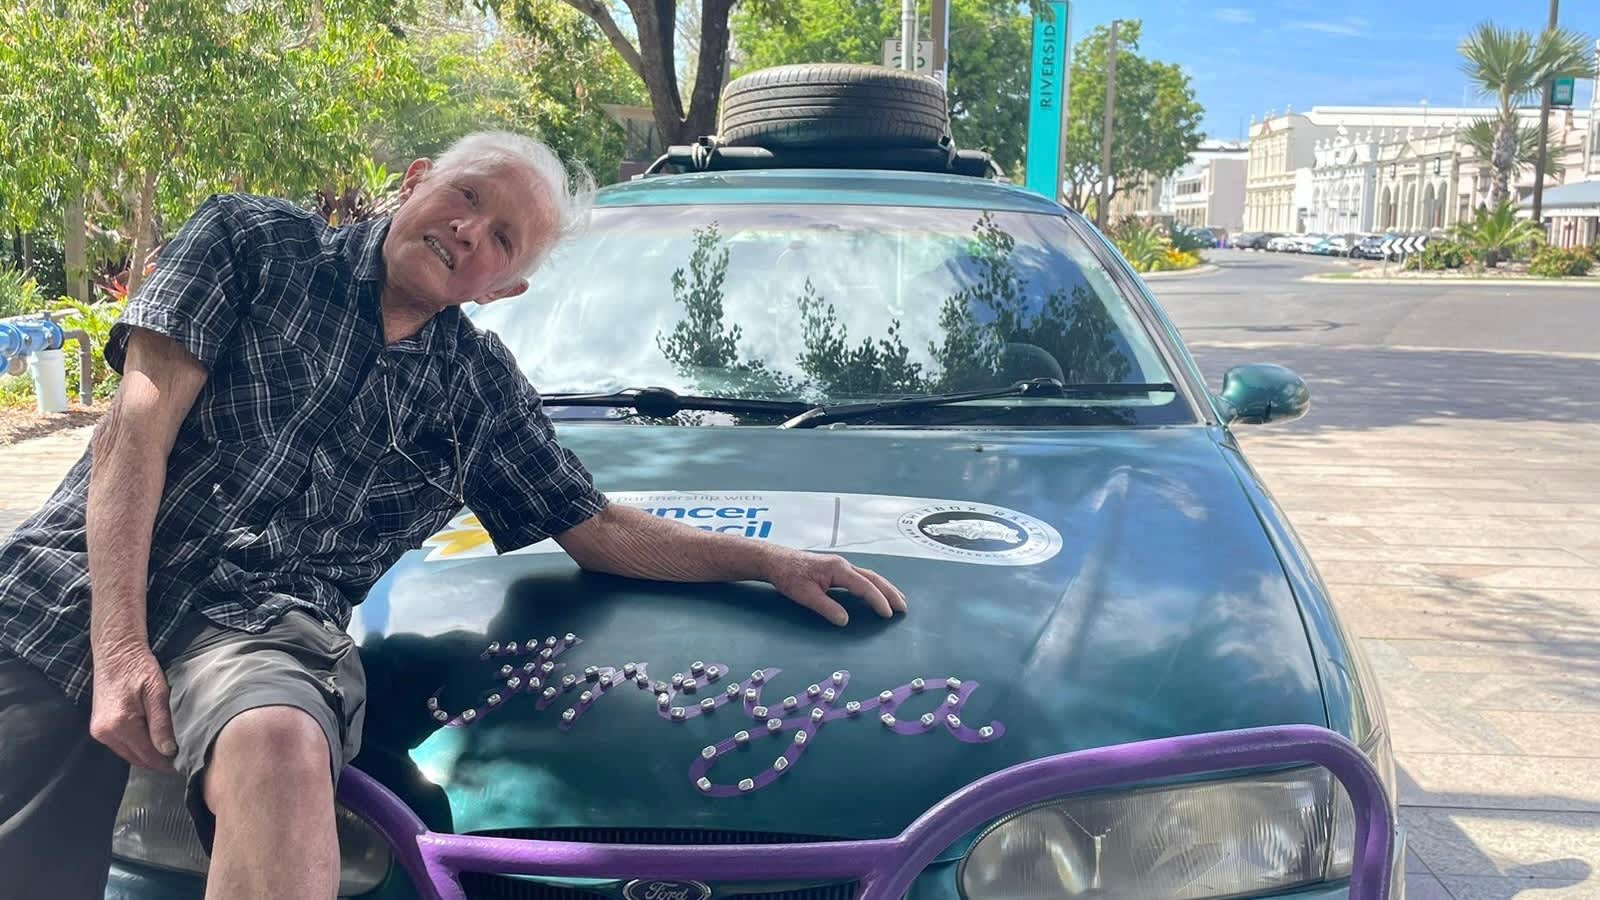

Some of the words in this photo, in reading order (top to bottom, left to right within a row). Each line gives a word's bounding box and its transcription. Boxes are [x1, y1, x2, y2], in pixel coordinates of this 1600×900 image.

[895, 42, 923, 52] ED
[1040, 24, 1056, 108] RIVERSID
[641, 506, 769, 519] ncer
[645, 882, 689, 900] Ford
